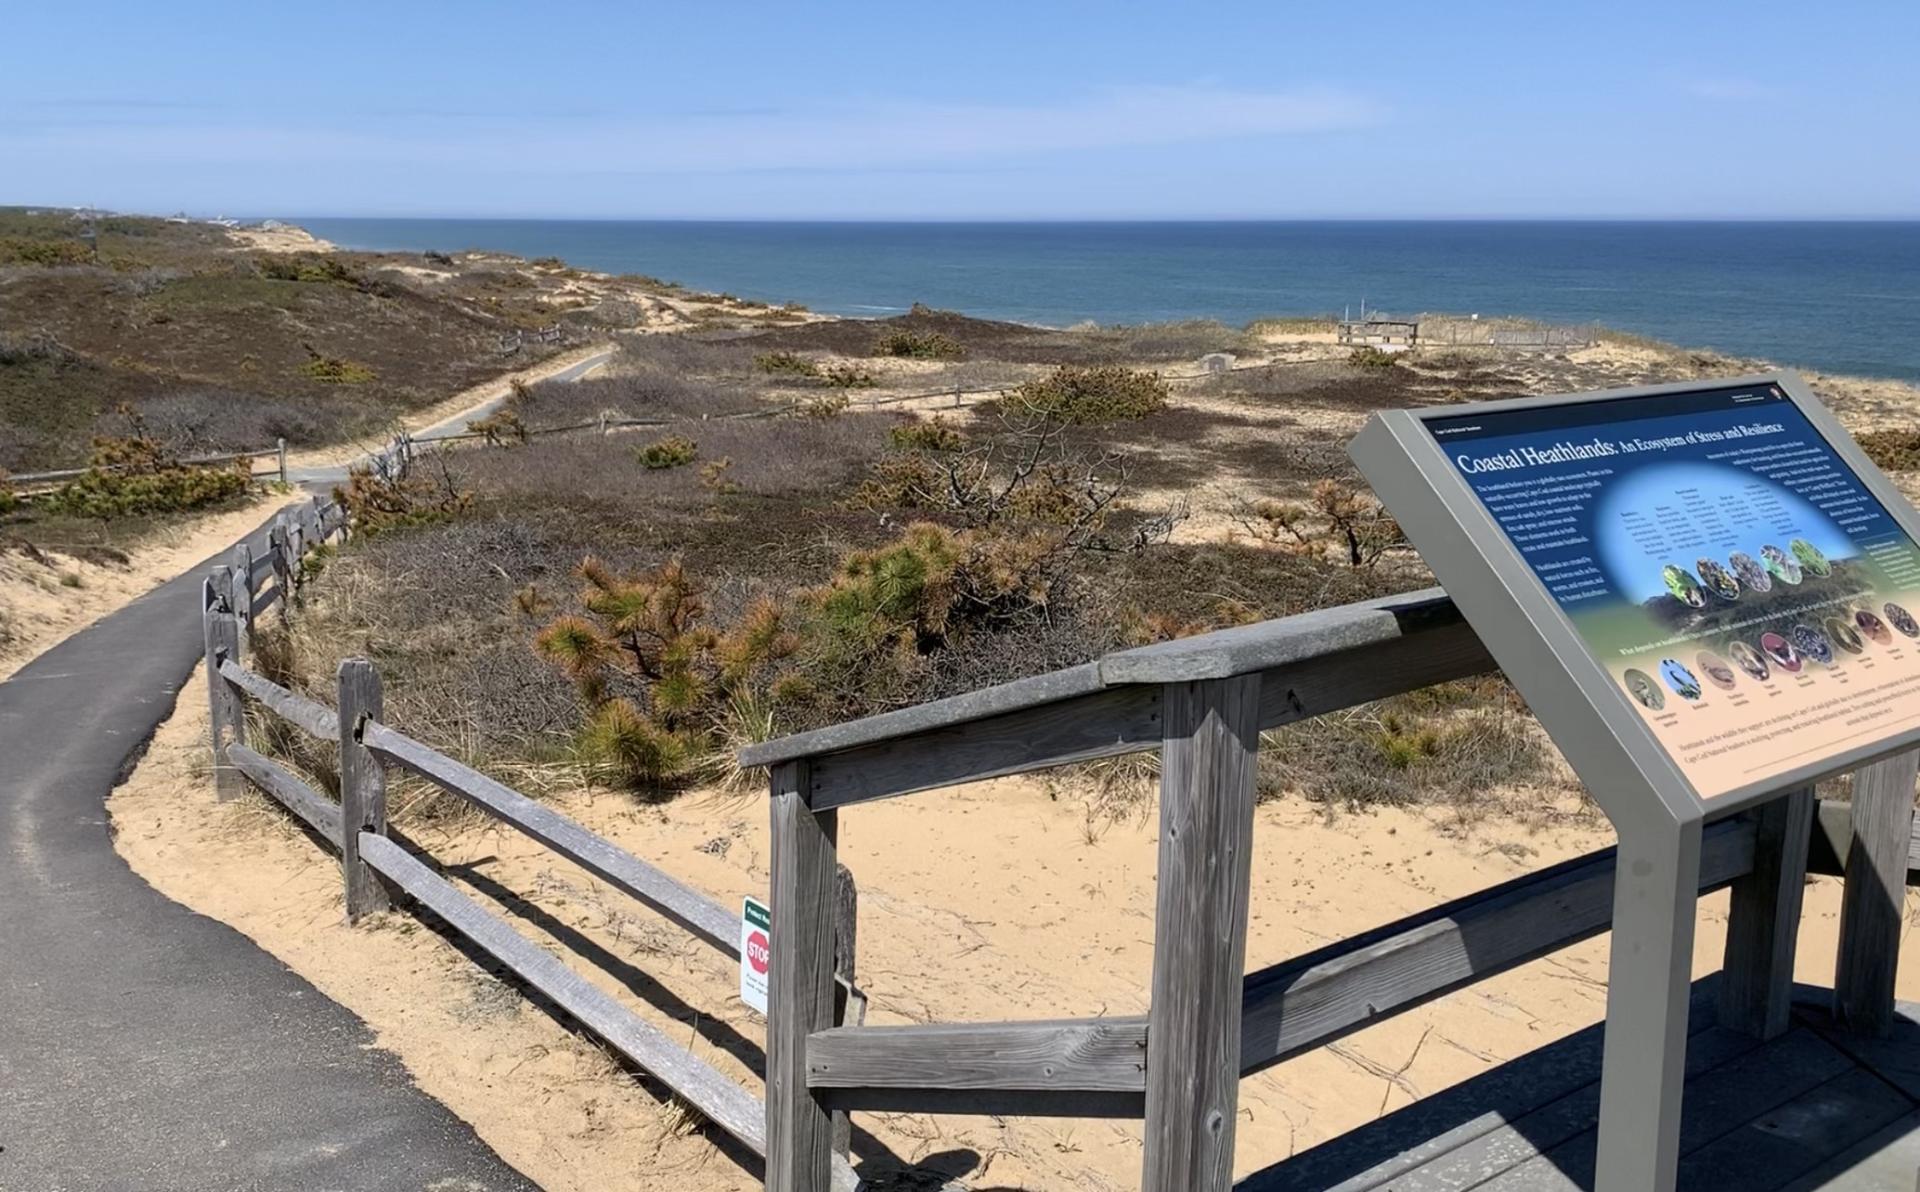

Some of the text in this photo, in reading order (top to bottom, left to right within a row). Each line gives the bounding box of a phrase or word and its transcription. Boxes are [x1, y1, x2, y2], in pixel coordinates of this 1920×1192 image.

[1457, 422, 1785, 474] Coastal Heathlands: An Ecosystem of Stress and Resilience
[748, 941, 769, 964] STOP
